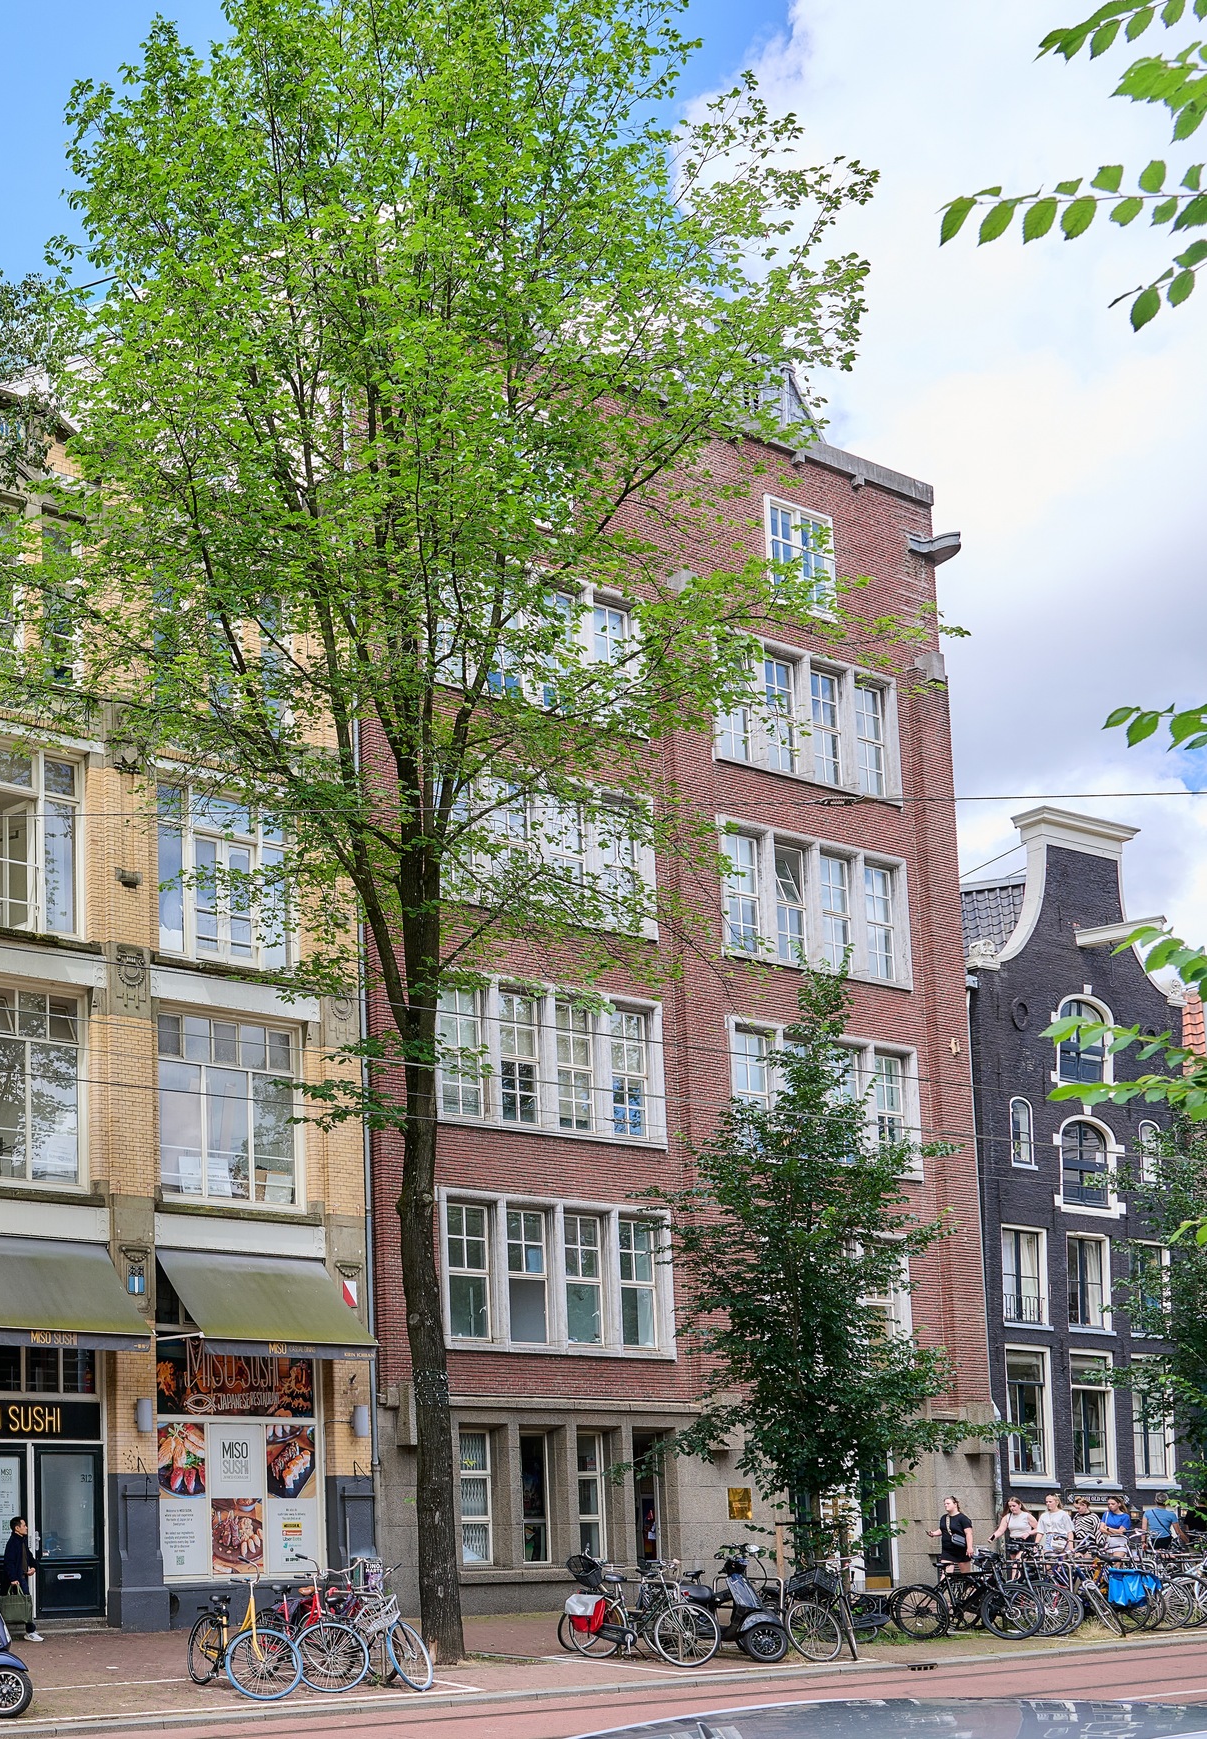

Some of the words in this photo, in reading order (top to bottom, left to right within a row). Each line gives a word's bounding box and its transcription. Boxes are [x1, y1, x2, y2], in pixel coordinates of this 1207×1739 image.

[30, 1330, 52, 1345] MISO
[53, 1332, 78, 1346] SUSHI
[268, 1342, 287, 1355] MISO
[218, 1392, 250, 1411] JAPANESE
[249, 1391, 280, 1408] RESTAURANT
[8, 1405, 61, 1433] SUSHI
[222, 1441, 249, 1459] MISO
[0, 1468, 12, 1476] MISO
[222, 1459, 249, 1475] SUSHI
[80, 1474, 93, 1483] 312
